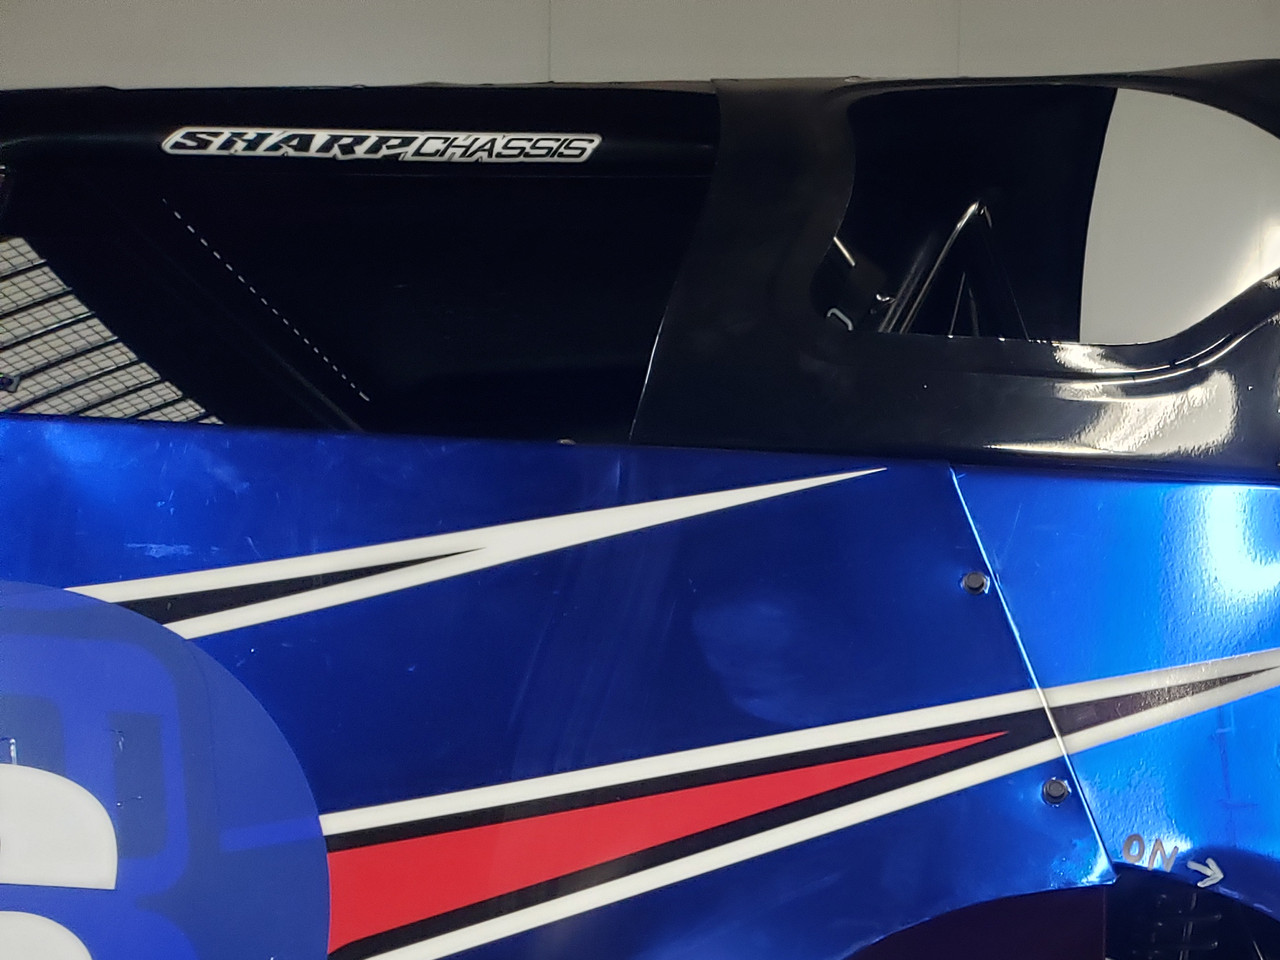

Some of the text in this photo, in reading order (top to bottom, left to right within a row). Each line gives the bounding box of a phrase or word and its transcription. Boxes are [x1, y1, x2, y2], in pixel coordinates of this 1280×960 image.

[169, 130, 590, 160] SHARP CHASSIS
[1122, 833, 1179, 873] ON
